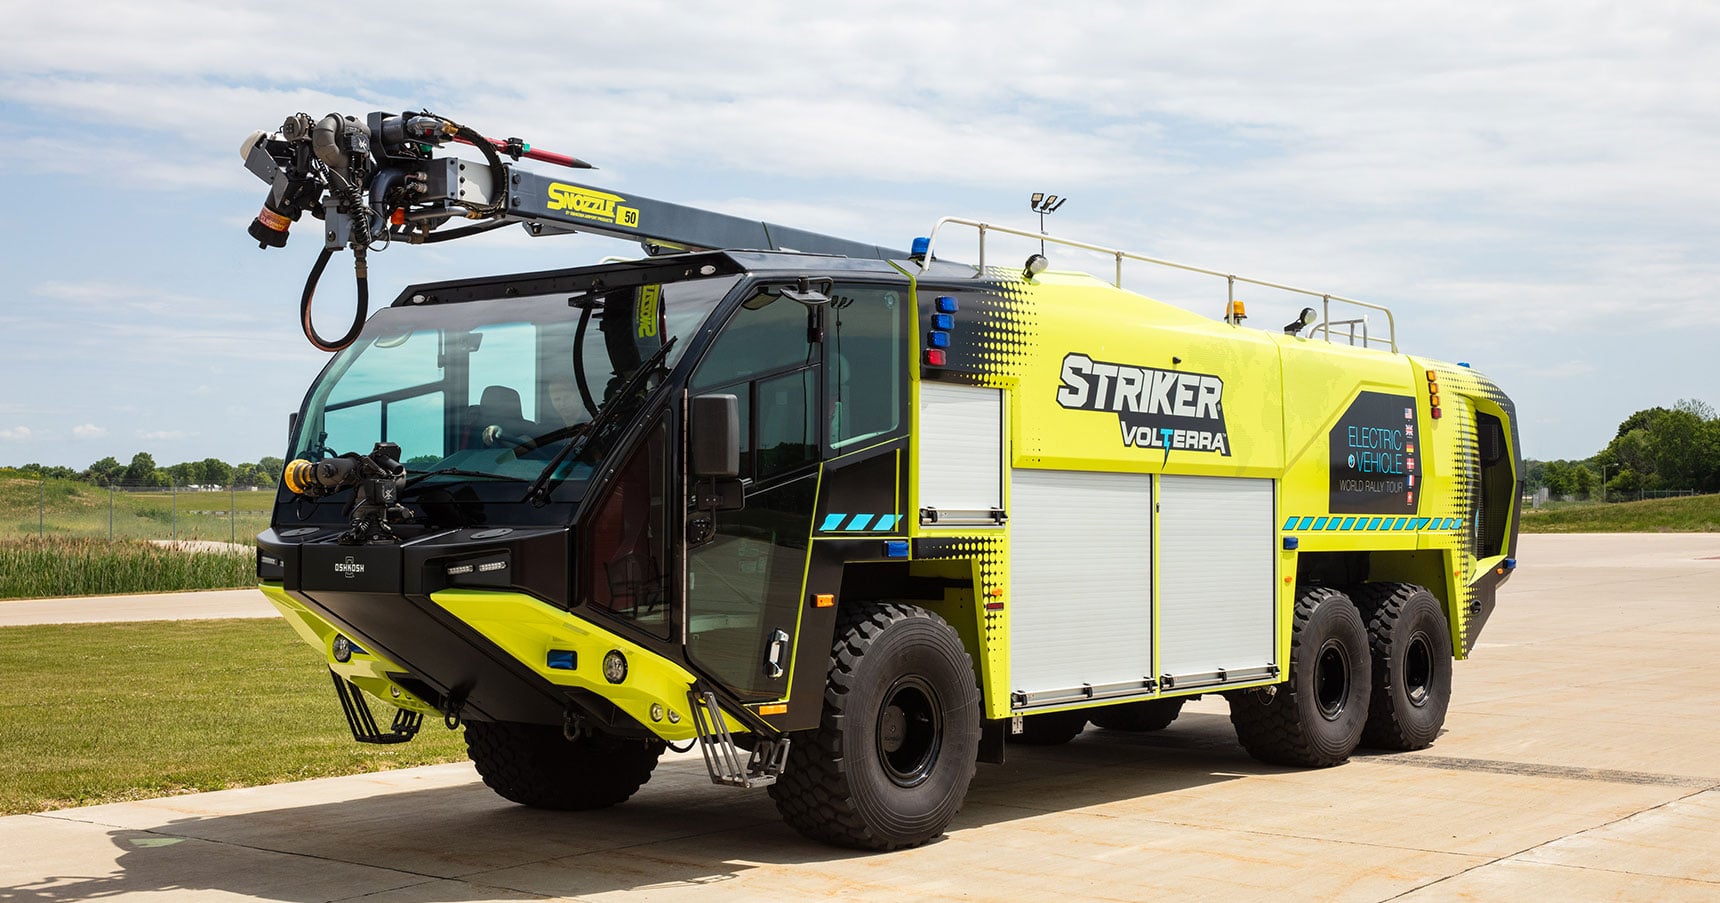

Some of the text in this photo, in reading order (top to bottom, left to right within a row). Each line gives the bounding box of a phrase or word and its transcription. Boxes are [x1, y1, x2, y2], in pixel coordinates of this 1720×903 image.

[547, 182, 637, 224] SNOZZLE 50
[1348, 425, 1403, 451] ELECTRIC
[1355, 451, 1403, 475] VEHICLE
[1339, 479, 1404, 494] WORLD RALLY TOUR
[335, 563, 365, 572] OSHKOSH
